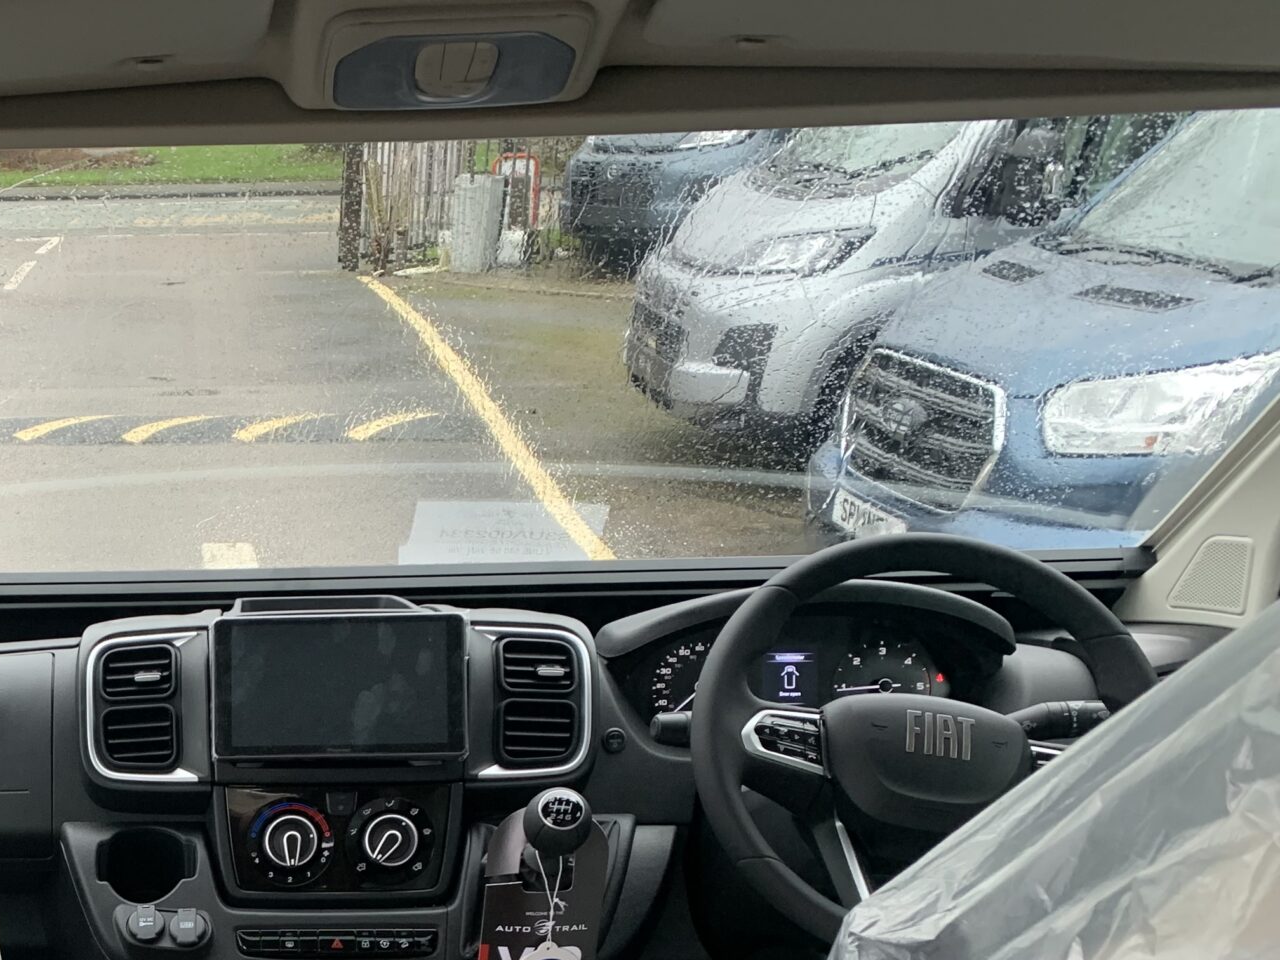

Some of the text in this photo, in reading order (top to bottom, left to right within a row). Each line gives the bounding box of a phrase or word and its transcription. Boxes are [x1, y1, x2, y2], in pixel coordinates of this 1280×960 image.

[904, 708, 976, 761] FIAT
[495, 923, 589, 934] AUTO TRAIL
